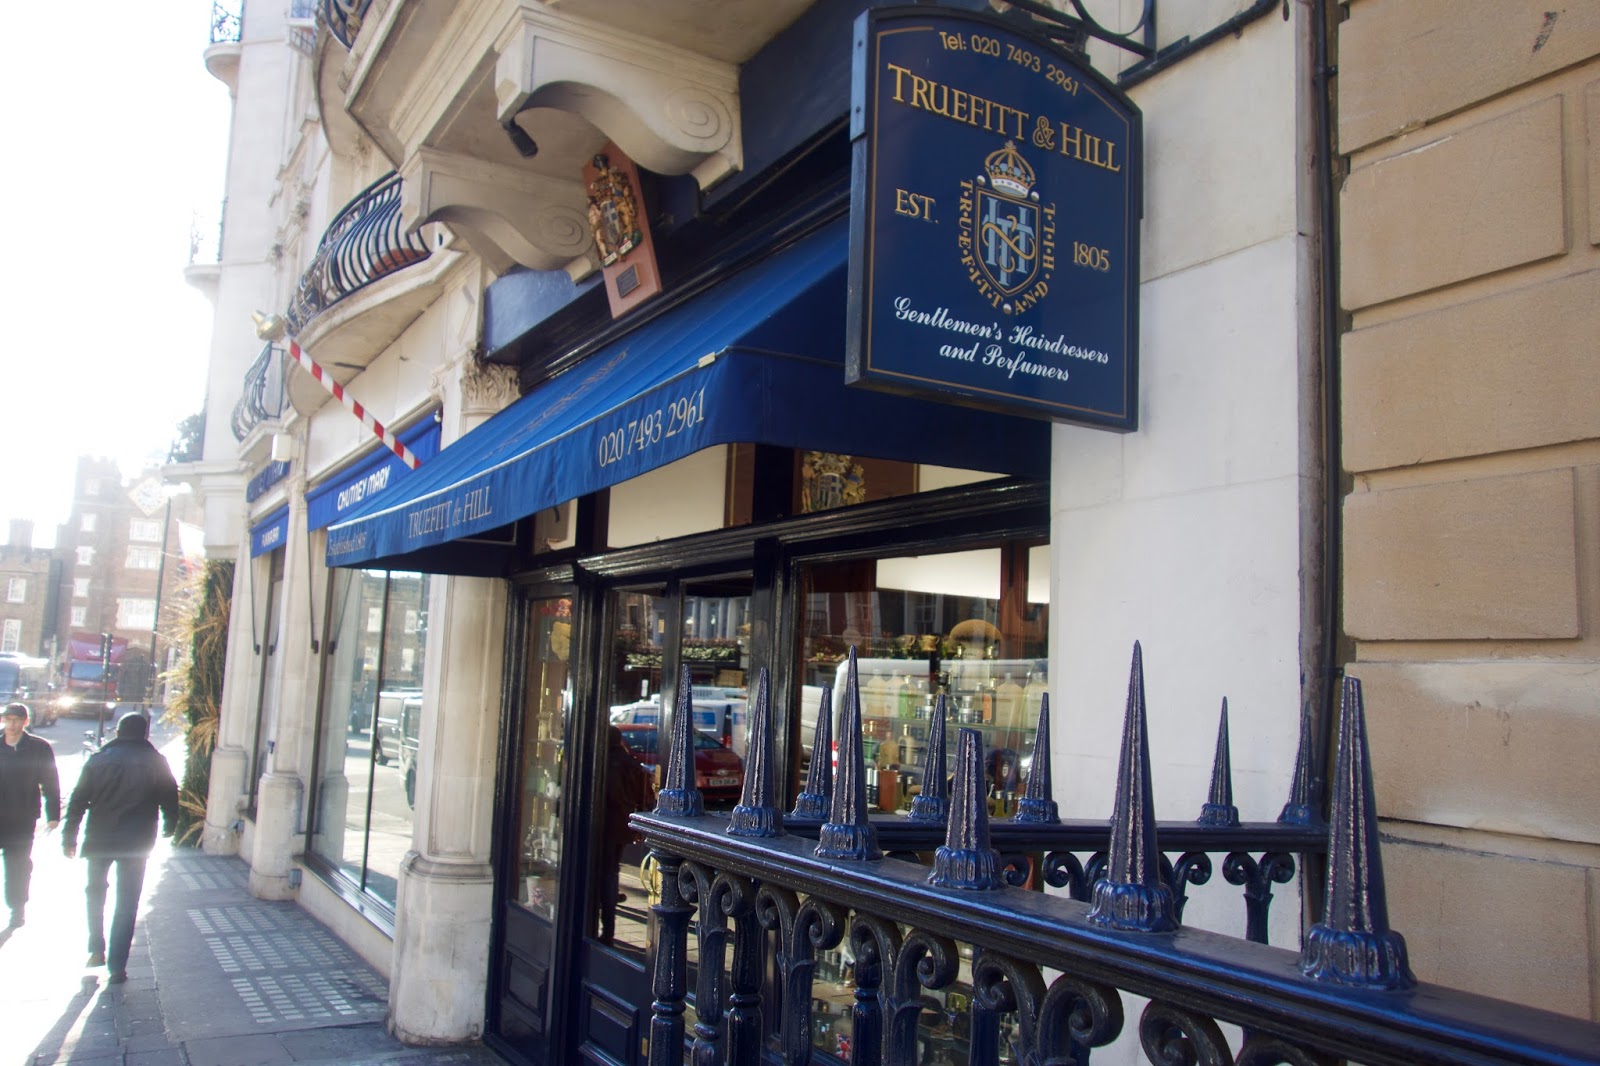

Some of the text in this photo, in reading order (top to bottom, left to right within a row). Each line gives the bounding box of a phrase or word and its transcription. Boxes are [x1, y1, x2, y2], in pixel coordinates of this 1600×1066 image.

[939, 31, 1079, 97] Tel: 020 7493 2961
[887, 63, 1121, 172] TRUEFITT & HILL
[895, 188, 939, 224] EST.
[1072, 241, 1111, 273] 1805
[894, 296, 1110, 365] Gentlemen's Hairdressers
[939, 342, 1070, 382] and Perfumers
[599, 428, 624, 468] 020
[627, 409, 662, 455] 7493
[666, 386, 706, 438] 2961
[408, 500, 453, 539] TRUEFITT
[462, 486, 493, 522] HILL
